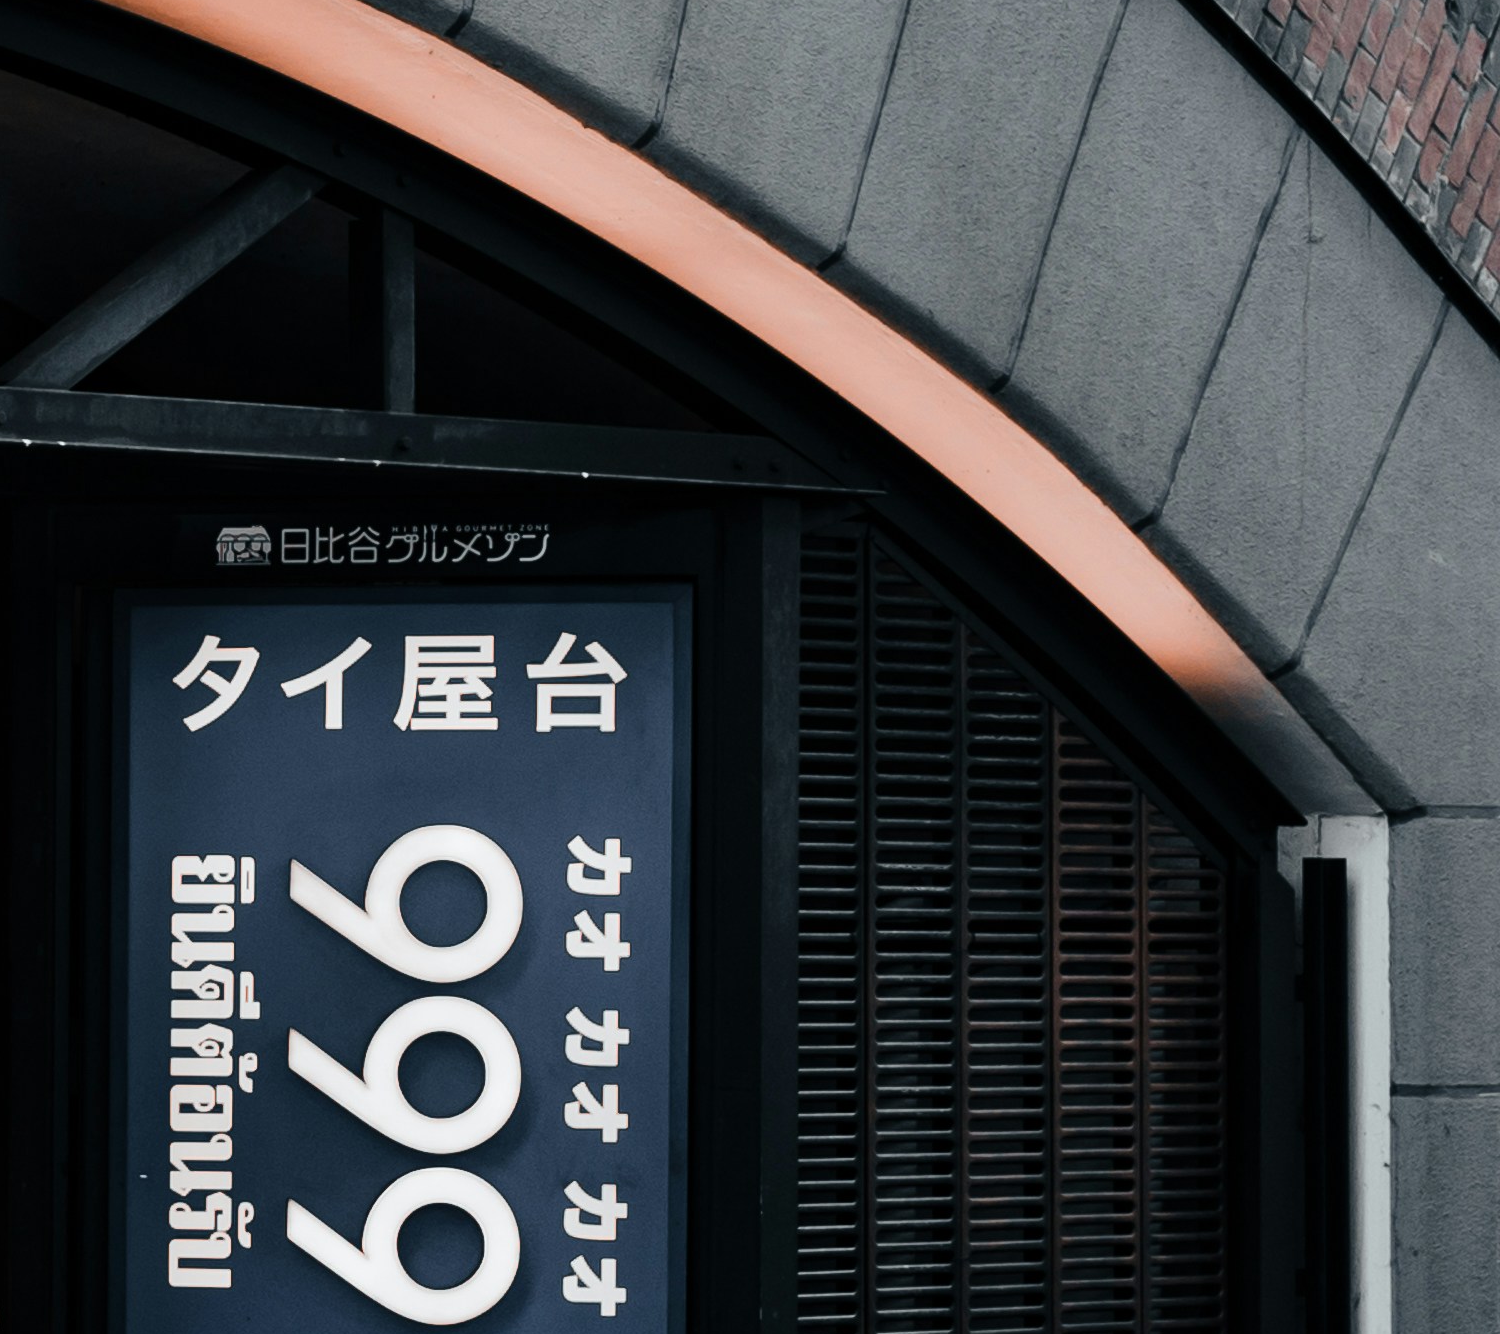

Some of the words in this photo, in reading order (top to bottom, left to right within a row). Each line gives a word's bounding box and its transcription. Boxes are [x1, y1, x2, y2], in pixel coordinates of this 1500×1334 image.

[281, 526, 550, 563] 日比谷グルメゾン
[172, 632, 628, 732] タイ屋台
[566, 834, 632, 971] カオ
[169, 854, 260, 1289] ยินดีต้อนรับ
[286, 824, 523, 1325] 999
[564, 1006, 630, 1143] カオ
[562, 1181, 628, 1317] カオ
